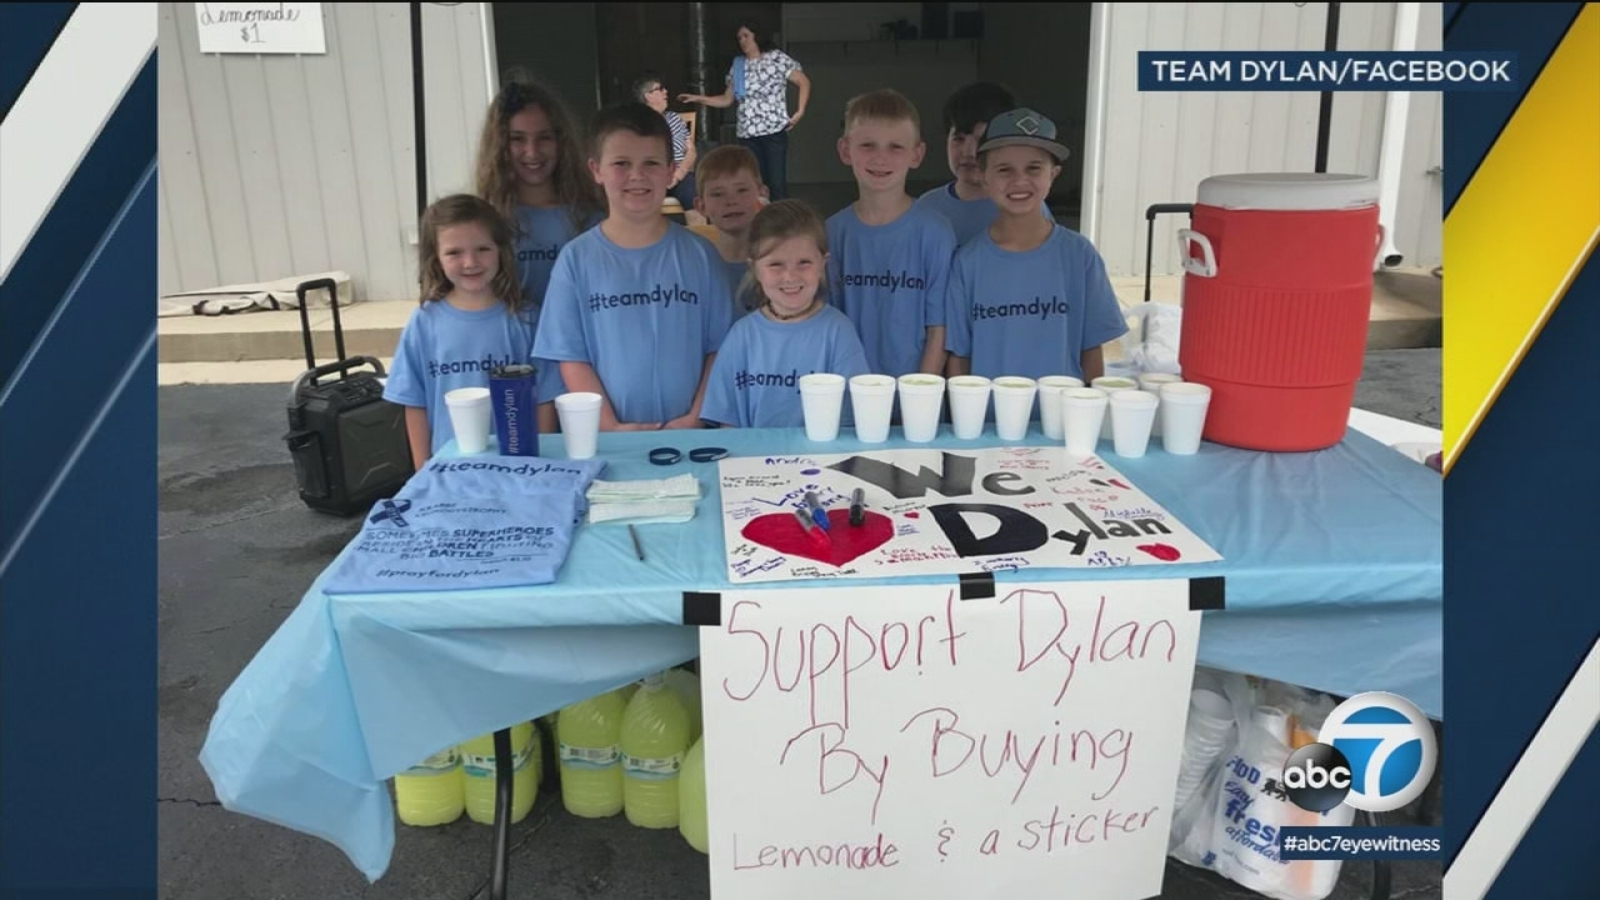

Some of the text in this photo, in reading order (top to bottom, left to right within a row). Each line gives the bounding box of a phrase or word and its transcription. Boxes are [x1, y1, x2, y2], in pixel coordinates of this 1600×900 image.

[240, 22, 266, 43] $1
[519, 244, 559, 261] amd
[840, 269, 925, 294] eamdylan
[589, 282, 699, 313] #teamdylan
[973, 295, 1070, 321] #teamdyla
[428, 353, 521, 379] #eamdyl
[735, 368, 815, 395] #eamd
[429, 461, 582, 476] #teamdylan
[825, 451, 1036, 499] We
[927, 502, 1173, 556] Dylan
[723, 588, 1176, 729] Support Dylan
[780, 707, 1133, 826] By Buying
[1225, 798, 1280, 847] fres
[733, 832, 900, 871] Lemonade
[979, 828, 1001, 855] a
[1017, 805, 1160, 853] sticker
